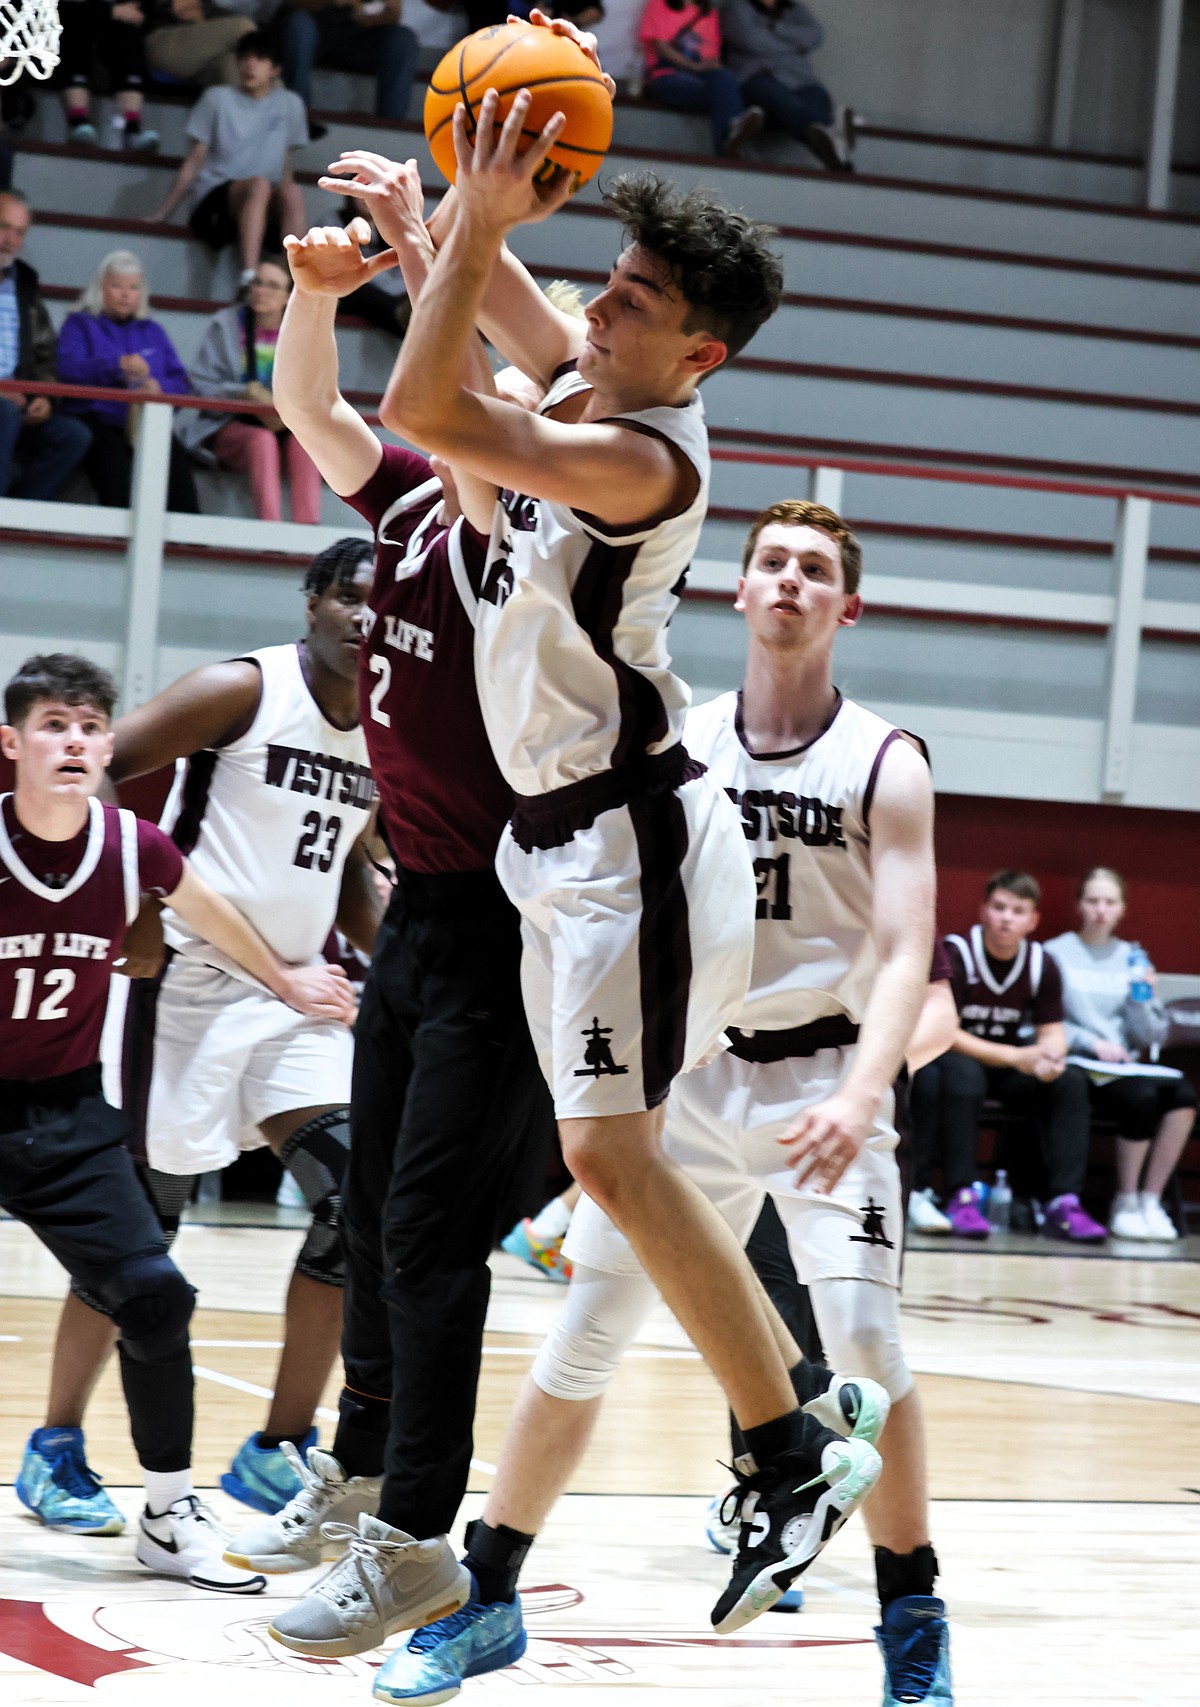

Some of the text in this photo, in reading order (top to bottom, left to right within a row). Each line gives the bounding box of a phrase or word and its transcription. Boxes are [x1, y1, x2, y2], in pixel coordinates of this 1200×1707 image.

[384, 615, 434, 662] LIFE
[369, 653, 391, 728] 2
[265, 744, 376, 810] WESTSID
[294, 810, 341, 873] 23
[723, 787, 848, 849] STSIDE
[753, 853, 792, 920] 21
[52, 932, 112, 960] LIFE
[11, 967, 77, 1020] 12
